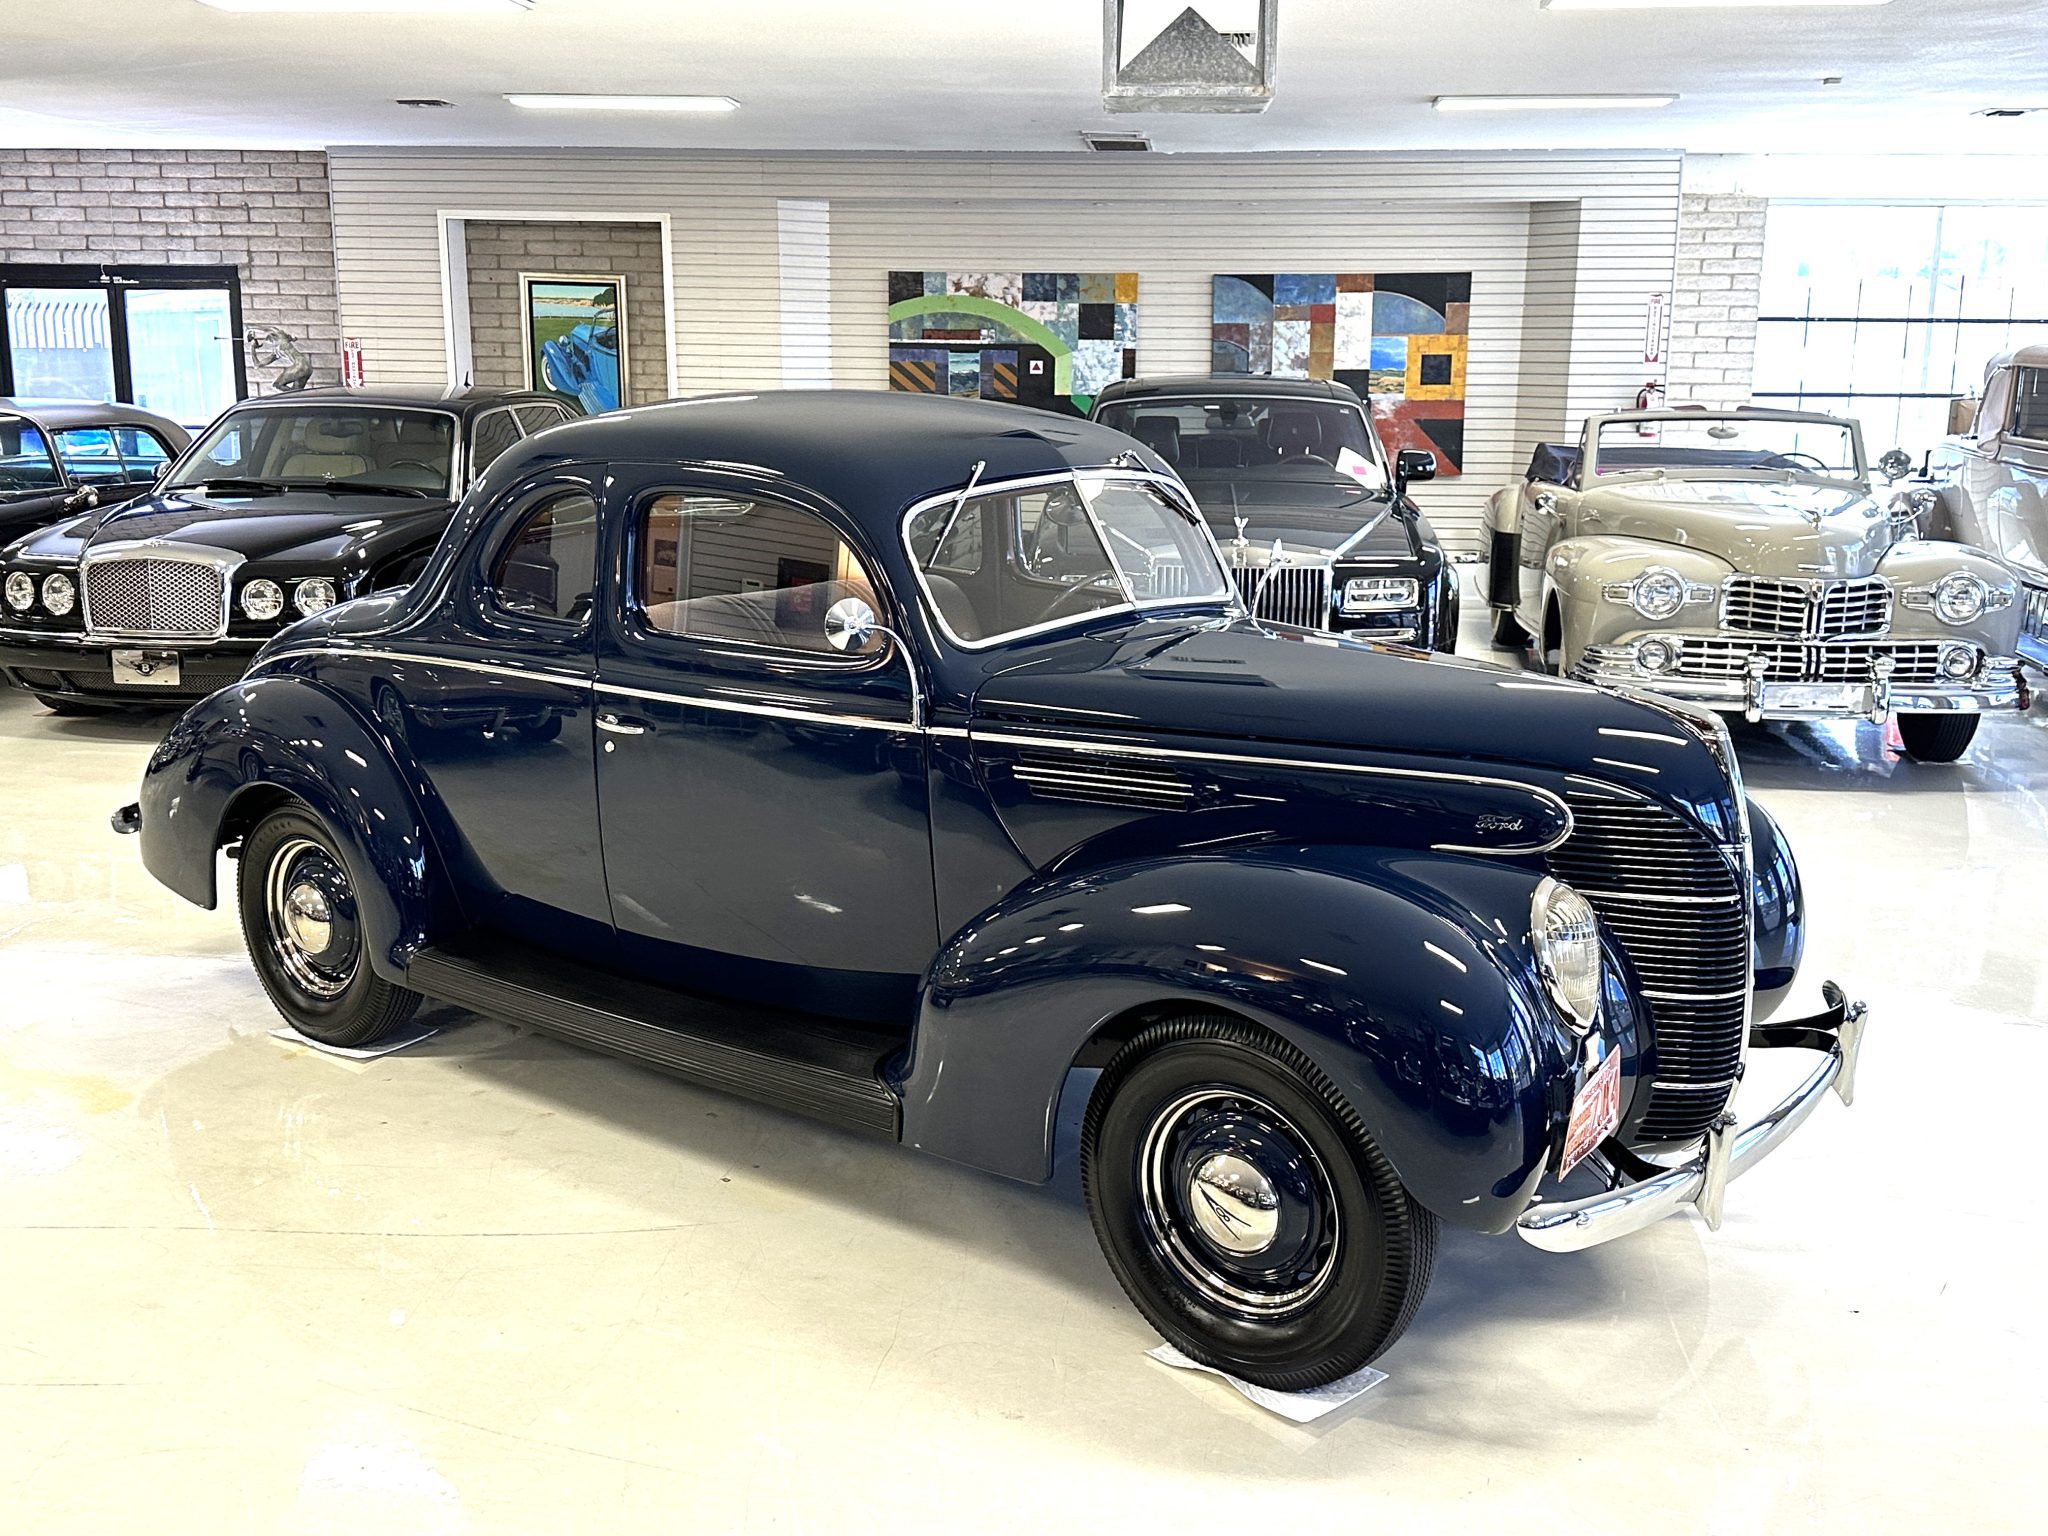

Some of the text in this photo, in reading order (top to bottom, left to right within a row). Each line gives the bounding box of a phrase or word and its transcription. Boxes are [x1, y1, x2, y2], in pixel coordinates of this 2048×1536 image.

[344, 341, 360, 349] FIRE
[141, 663, 150, 672] B
[1475, 813, 1524, 835] Ford
